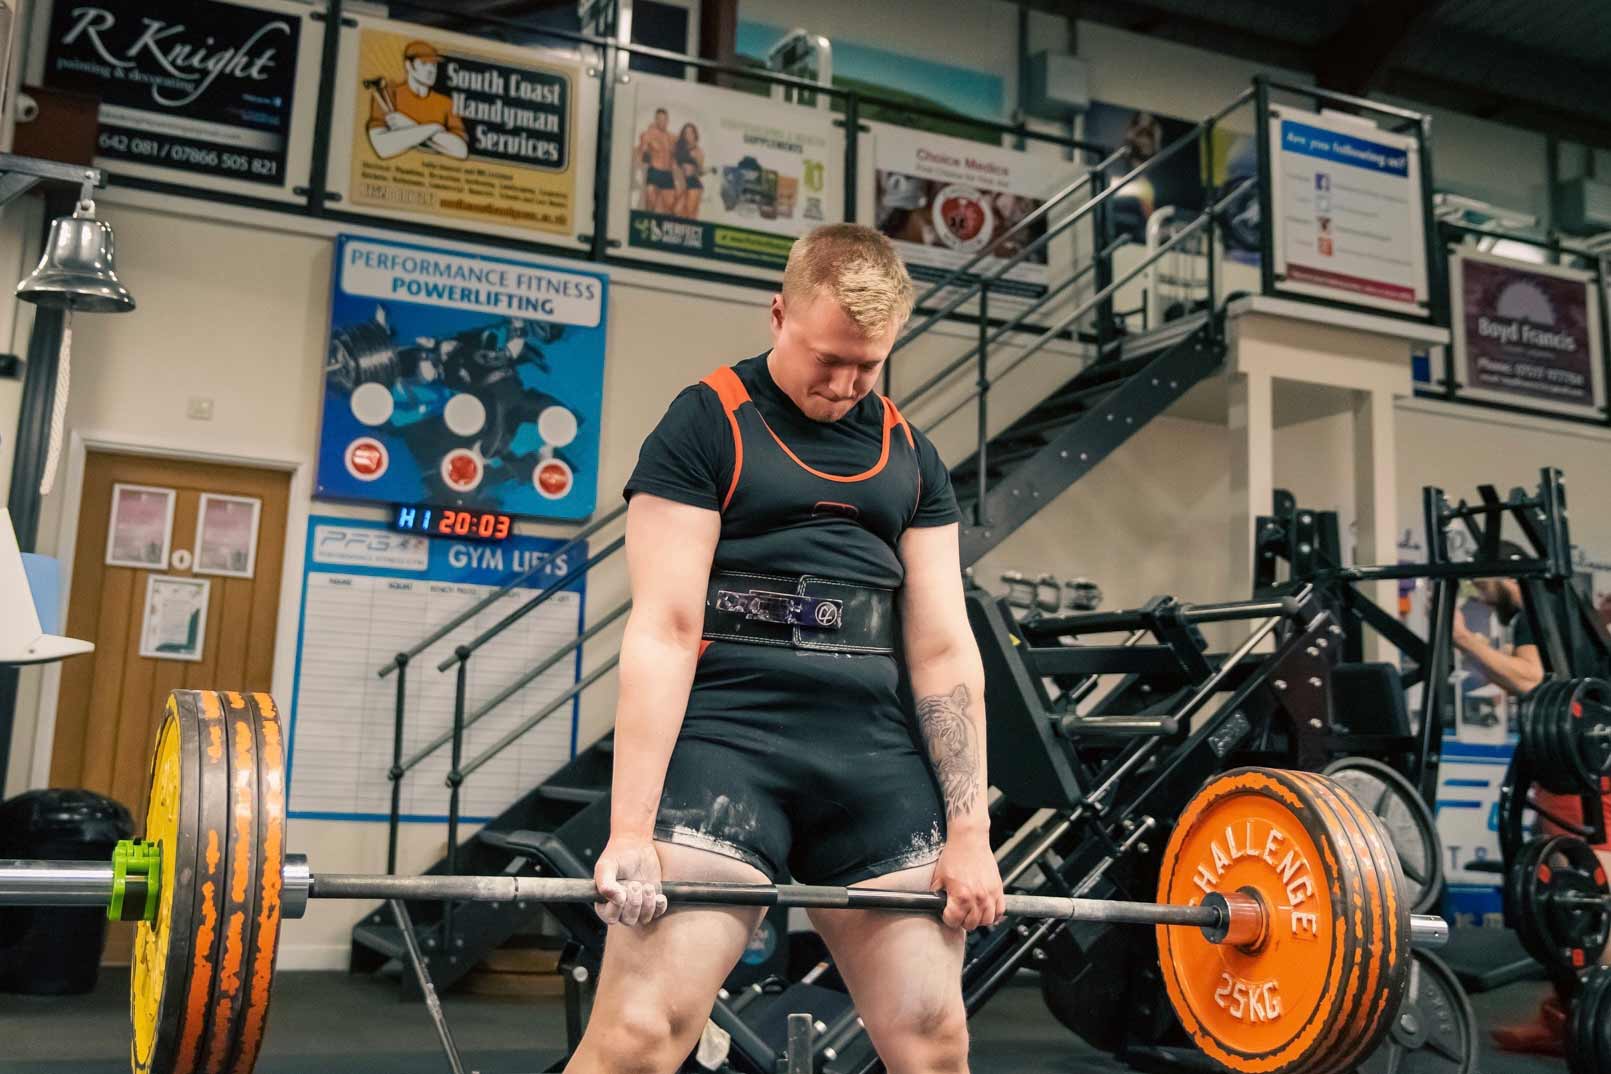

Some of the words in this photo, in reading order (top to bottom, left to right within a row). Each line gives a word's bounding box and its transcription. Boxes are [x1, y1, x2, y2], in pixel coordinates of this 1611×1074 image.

[61, 7, 136, 67] R
[127, 20, 291, 106] Knight
[447, 62, 504, 97] South
[509, 74, 561, 106] Coast
[452, 92, 559, 133] Handyman
[475, 124, 559, 162] Services
[350, 248, 509, 289] PERFORMANCE
[516, 273, 596, 301] FITNESS
[391, 277, 555, 316] POWERLIFTING
[1478, 316, 1518, 344] Boyd
[1521, 325, 1576, 353] Francis
[438, 510, 511, 539] 20:03
[448, 544, 504, 572] GYM
[1188, 820, 1318, 938] HALLENGE
[1214, 972, 1283, 1022] 25KG
